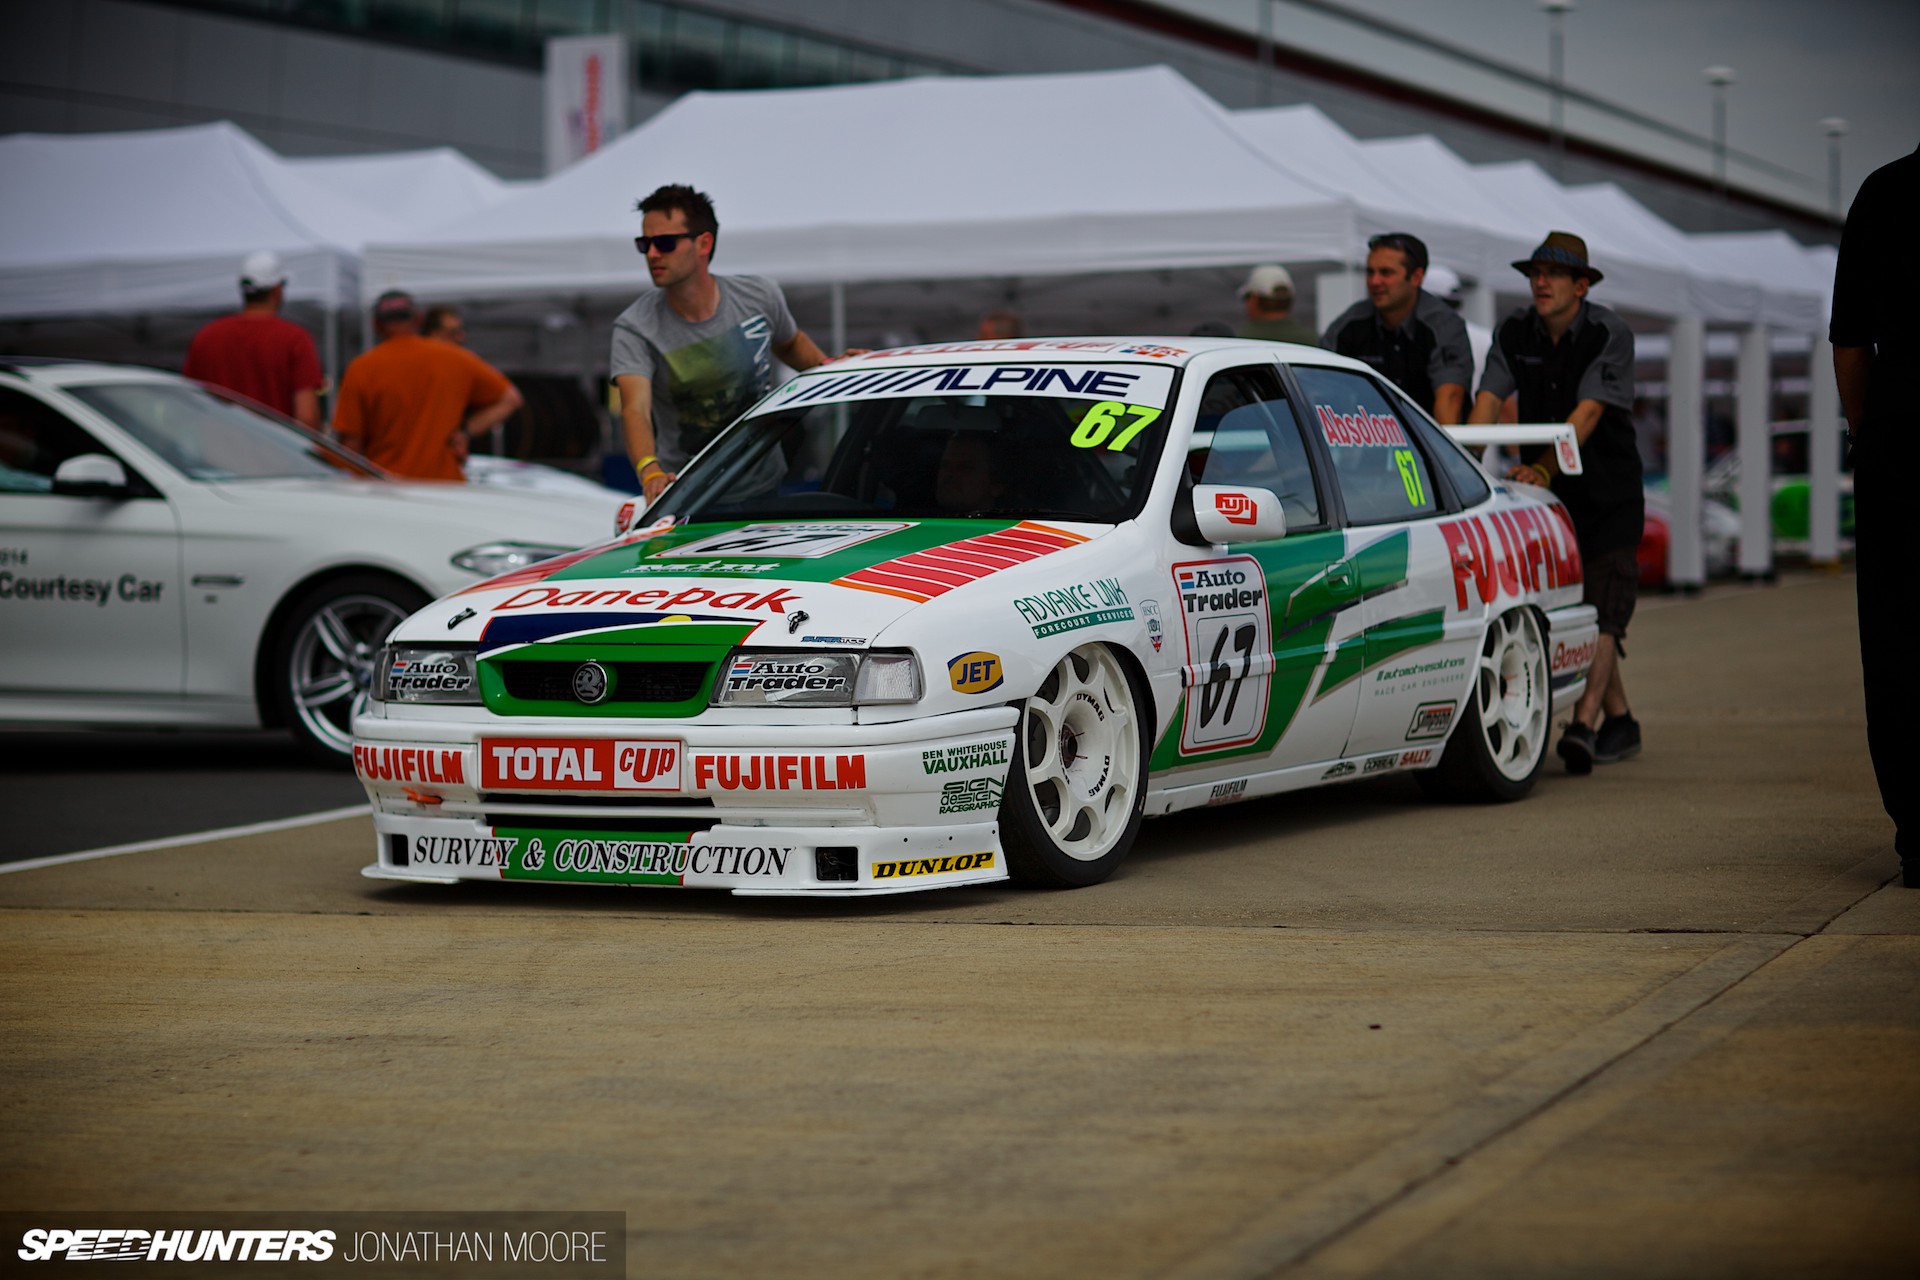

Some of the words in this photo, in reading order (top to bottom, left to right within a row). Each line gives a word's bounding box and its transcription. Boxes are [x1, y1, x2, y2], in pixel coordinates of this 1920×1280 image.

[893, 368, 1141, 398] ALPINE
[1070, 401, 1162, 451] 67
[1315, 405, 1408, 448] Absolom
[1394, 449, 1426, 507] 67
[0, 571, 111, 607] Courtesy
[118, 574, 164, 603] Car
[1196, 570, 1246, 588] Auto
[491, 587, 803, 614] Danepak
[1013, 584, 1098, 624] ADVANCE
[1089, 577, 1129, 607] LINK
[1183, 588, 1263, 613] Trader
[1034, 616, 1091, 637] FORECOURT
[1097, 610, 1134, 622] SERVICES
[404, 661, 458, 674] Auto
[750, 662, 826, 675] Auto
[956, 659, 996, 685] JET
[1200, 624, 1256, 729] 67
[389, 675, 471, 690] Trader
[728, 674, 846, 691] Trader
[1076, 693, 1105, 722] DYMAG
[922, 750, 943, 760] BEN
[947, 740, 1007, 756] WHITEHOUSE
[923, 750, 1008, 775] VAUXHALL
[353, 746, 465, 784] FUJIFILM
[493, 747, 602, 781] TOTAL
[695, 755, 867, 790] FUJIFILM
[1088, 755, 1110, 797] DYMAG
[1210, 779, 1248, 798] FUJIFILM
[939, 800, 1003, 814] RACEGRAPHICS
[413, 835, 519, 870] SURVEY
[522, 840, 544, 871] &
[554, 840, 792, 876] CONSTRUCTION
[874, 852, 994, 879] DUNLOP
